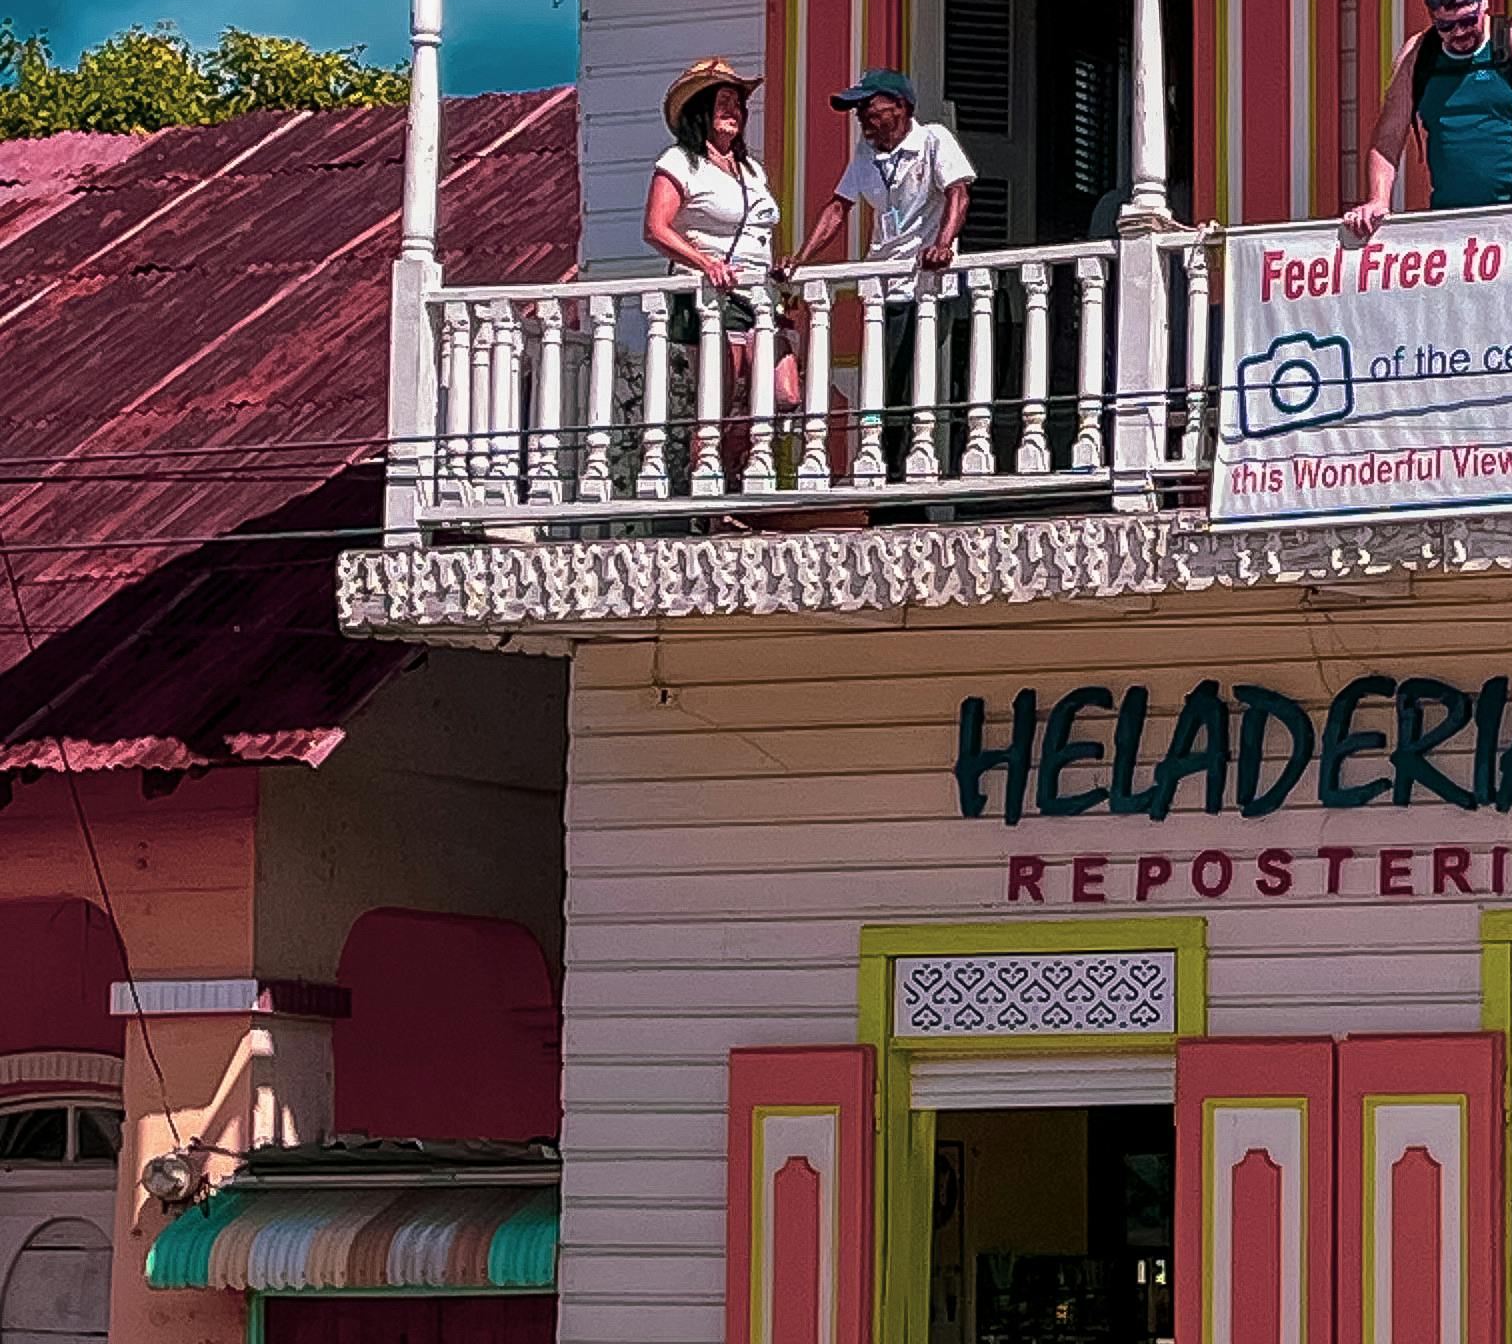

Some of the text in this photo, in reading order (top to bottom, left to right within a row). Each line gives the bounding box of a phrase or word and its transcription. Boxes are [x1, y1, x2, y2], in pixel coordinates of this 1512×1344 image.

[1260, 246, 1343, 303] Feel
[1357, 243, 1447, 293] Free
[1463, 236, 1501, 282] to
[1370, 345, 1405, 380] of
[1416, 344, 1471, 377] the
[1231, 462, 1284, 494] this
[1292, 447, 1443, 489] Wonderful
